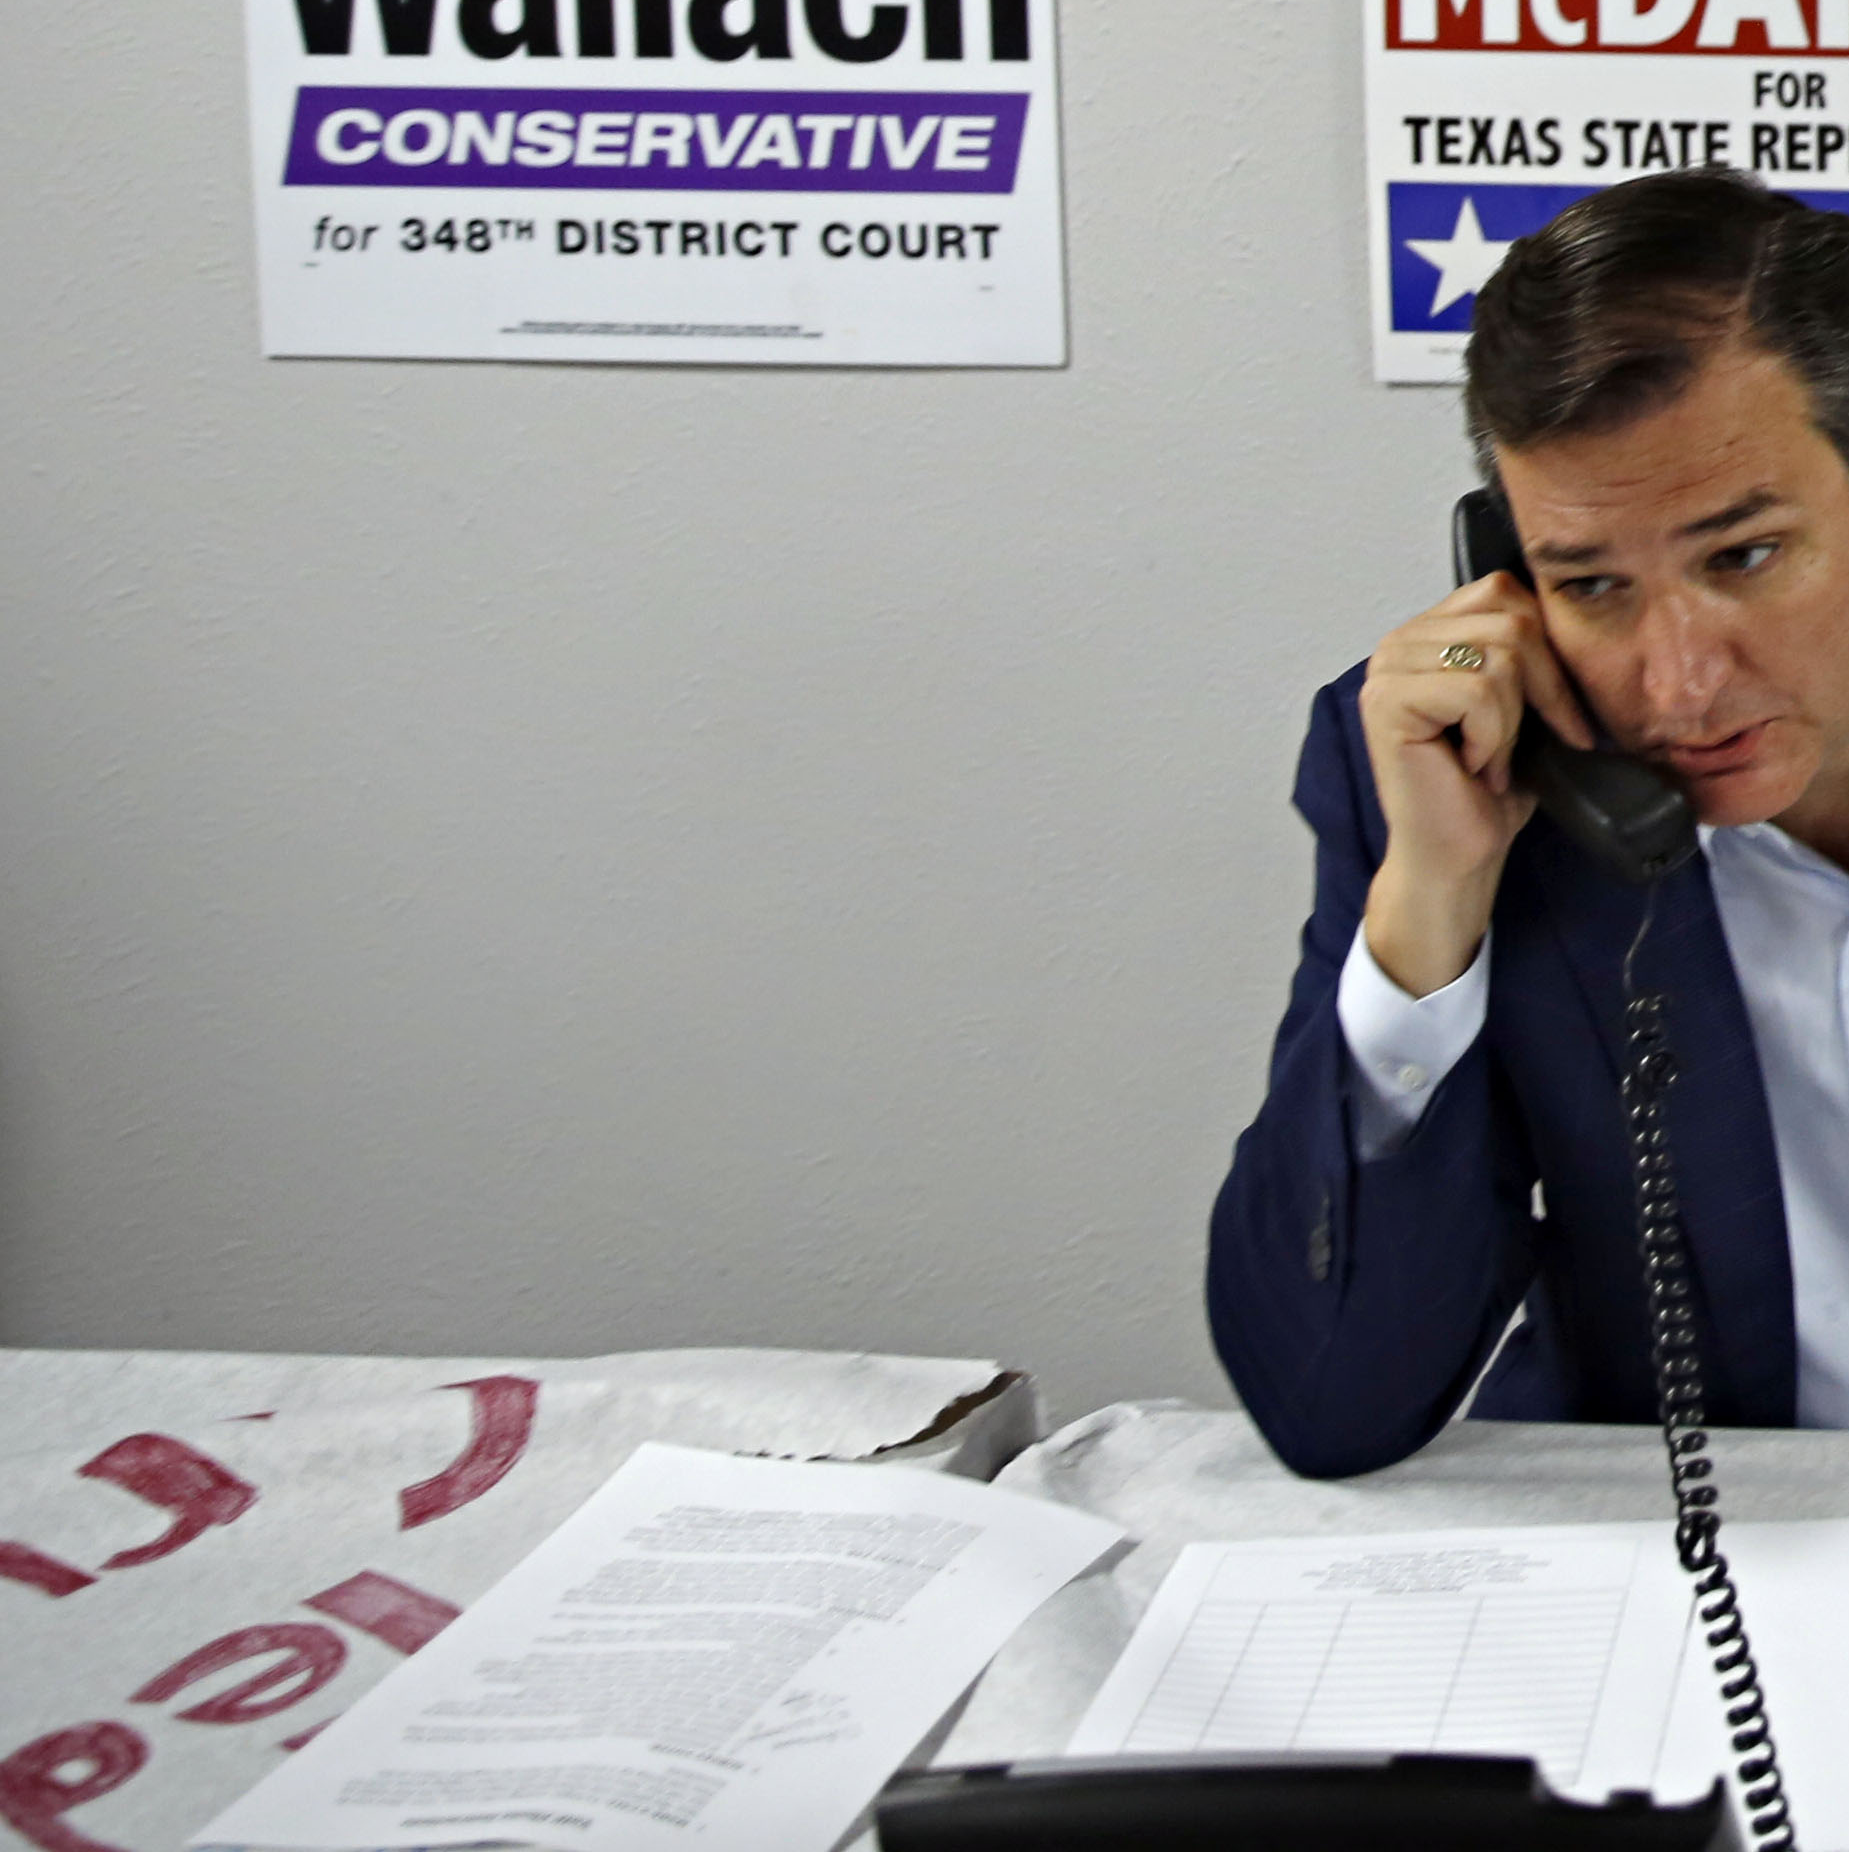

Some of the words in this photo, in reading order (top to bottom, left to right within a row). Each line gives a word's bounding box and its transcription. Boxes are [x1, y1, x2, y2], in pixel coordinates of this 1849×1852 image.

[1754, 73, 1826, 108] FOR
[316, 108, 996, 171] CONSERVATIVE
[1403, 117, 1560, 166] TEXAS
[1583, 120, 1731, 170] STATE
[313, 217, 379, 253] for
[556, 221, 799, 258] DISTRICT
[820, 224, 1001, 260] COURT
